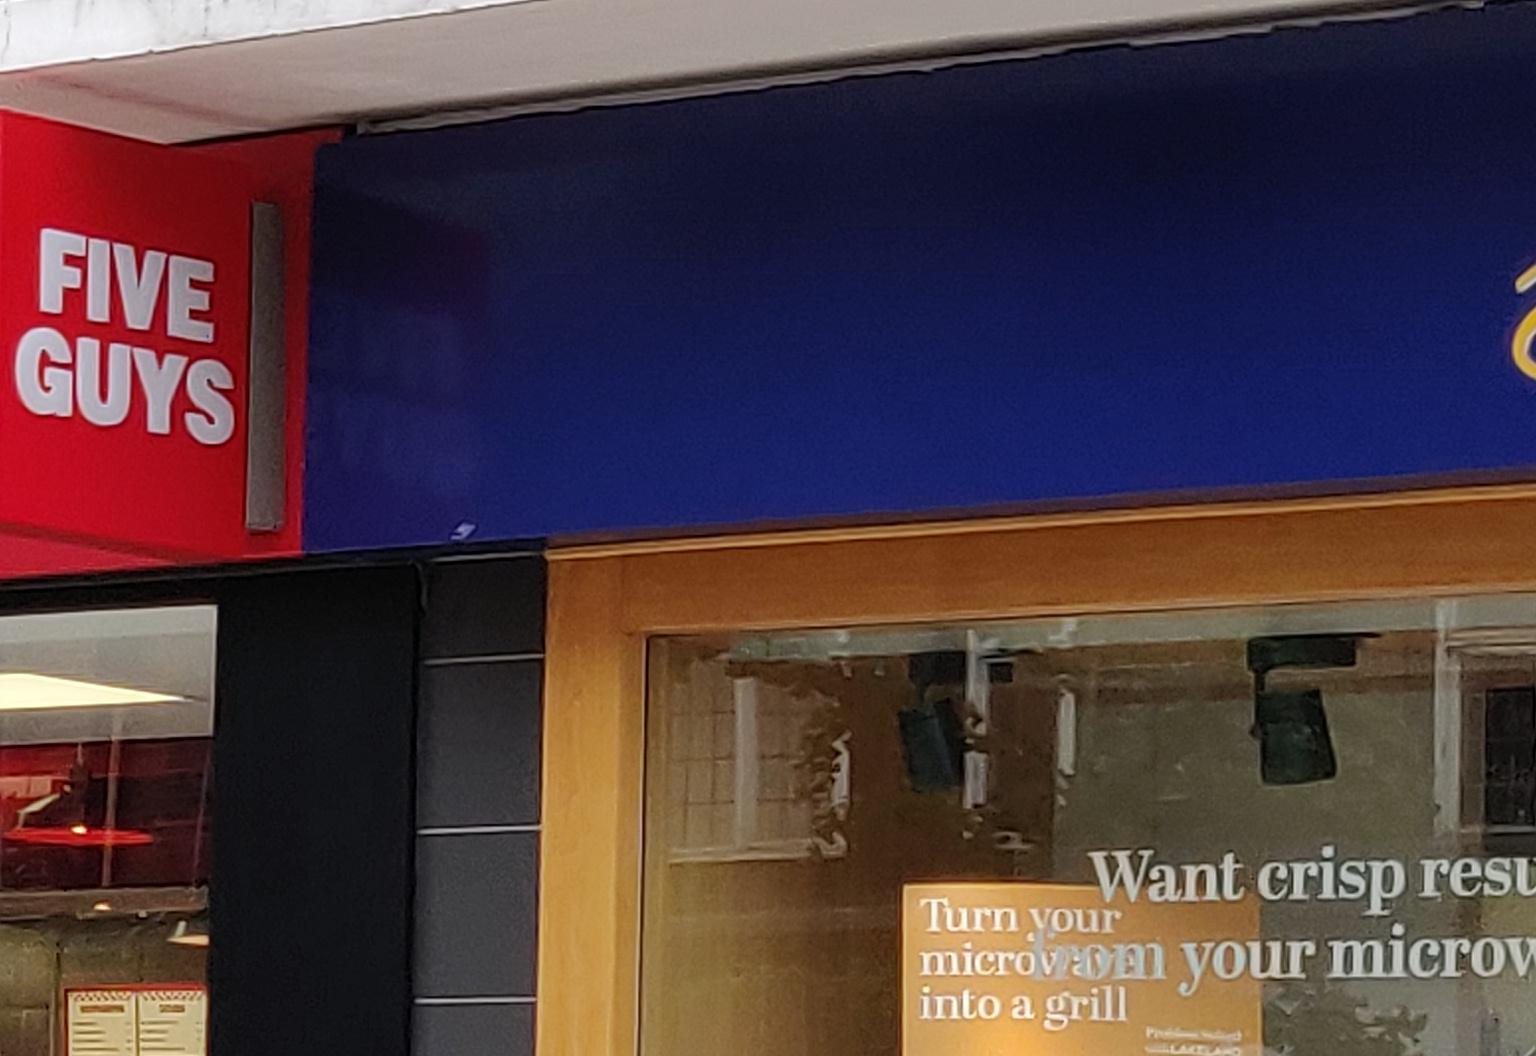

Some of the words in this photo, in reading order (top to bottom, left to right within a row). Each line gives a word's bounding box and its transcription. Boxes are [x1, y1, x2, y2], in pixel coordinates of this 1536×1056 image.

[39, 227, 215, 343] FIVE
[15, 327, 235, 445] GUYS
[1087, 850, 1246, 903] Want
[1257, 845, 1405, 917] crisp
[919, 897, 1019, 933] Turn
[1027, 906, 1122, 941] your
[1179, 938, 1316, 996] your
[919, 986, 1002, 1021] into
[1011, 994, 1036, 1021] a
[1043, 985, 1128, 1032] grill
